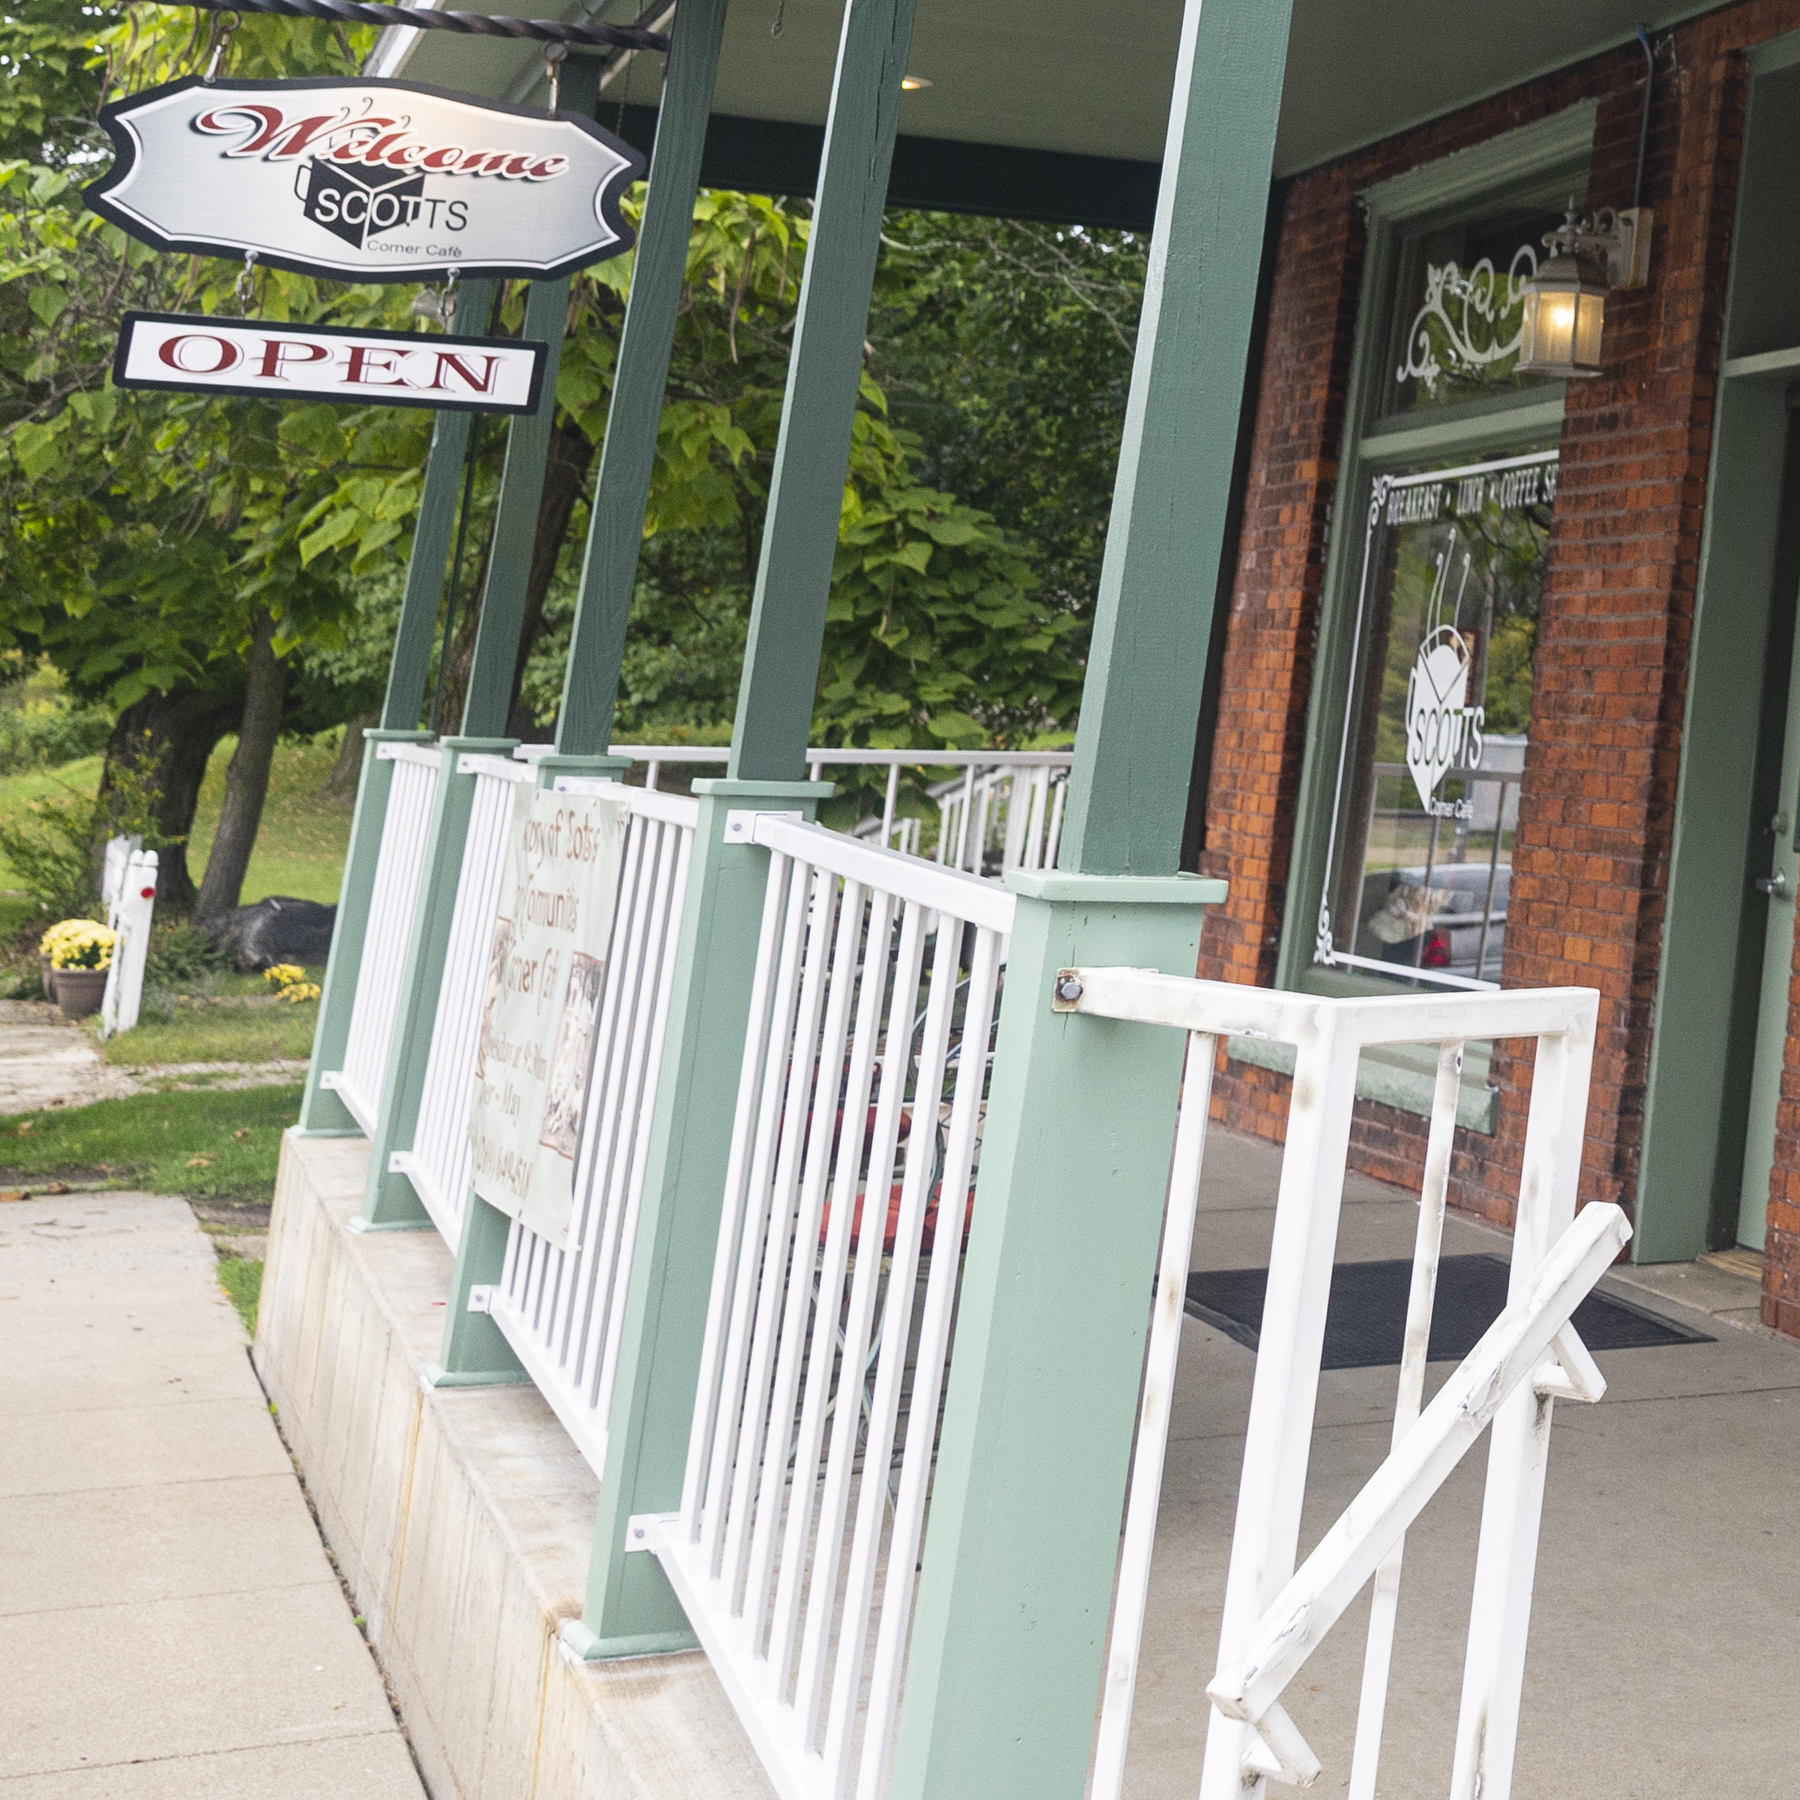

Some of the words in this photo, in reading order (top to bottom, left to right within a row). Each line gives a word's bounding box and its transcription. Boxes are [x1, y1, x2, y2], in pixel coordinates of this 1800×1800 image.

[197, 104, 569, 180] Welcome
[315, 188, 469, 231] SCOTTS
[367, 240, 421, 254] Corner
[158, 334, 506, 395] OPEN
[1500, 467, 1540, 510] COFFEE
[1411, 706, 1485, 769] SCOTTS
